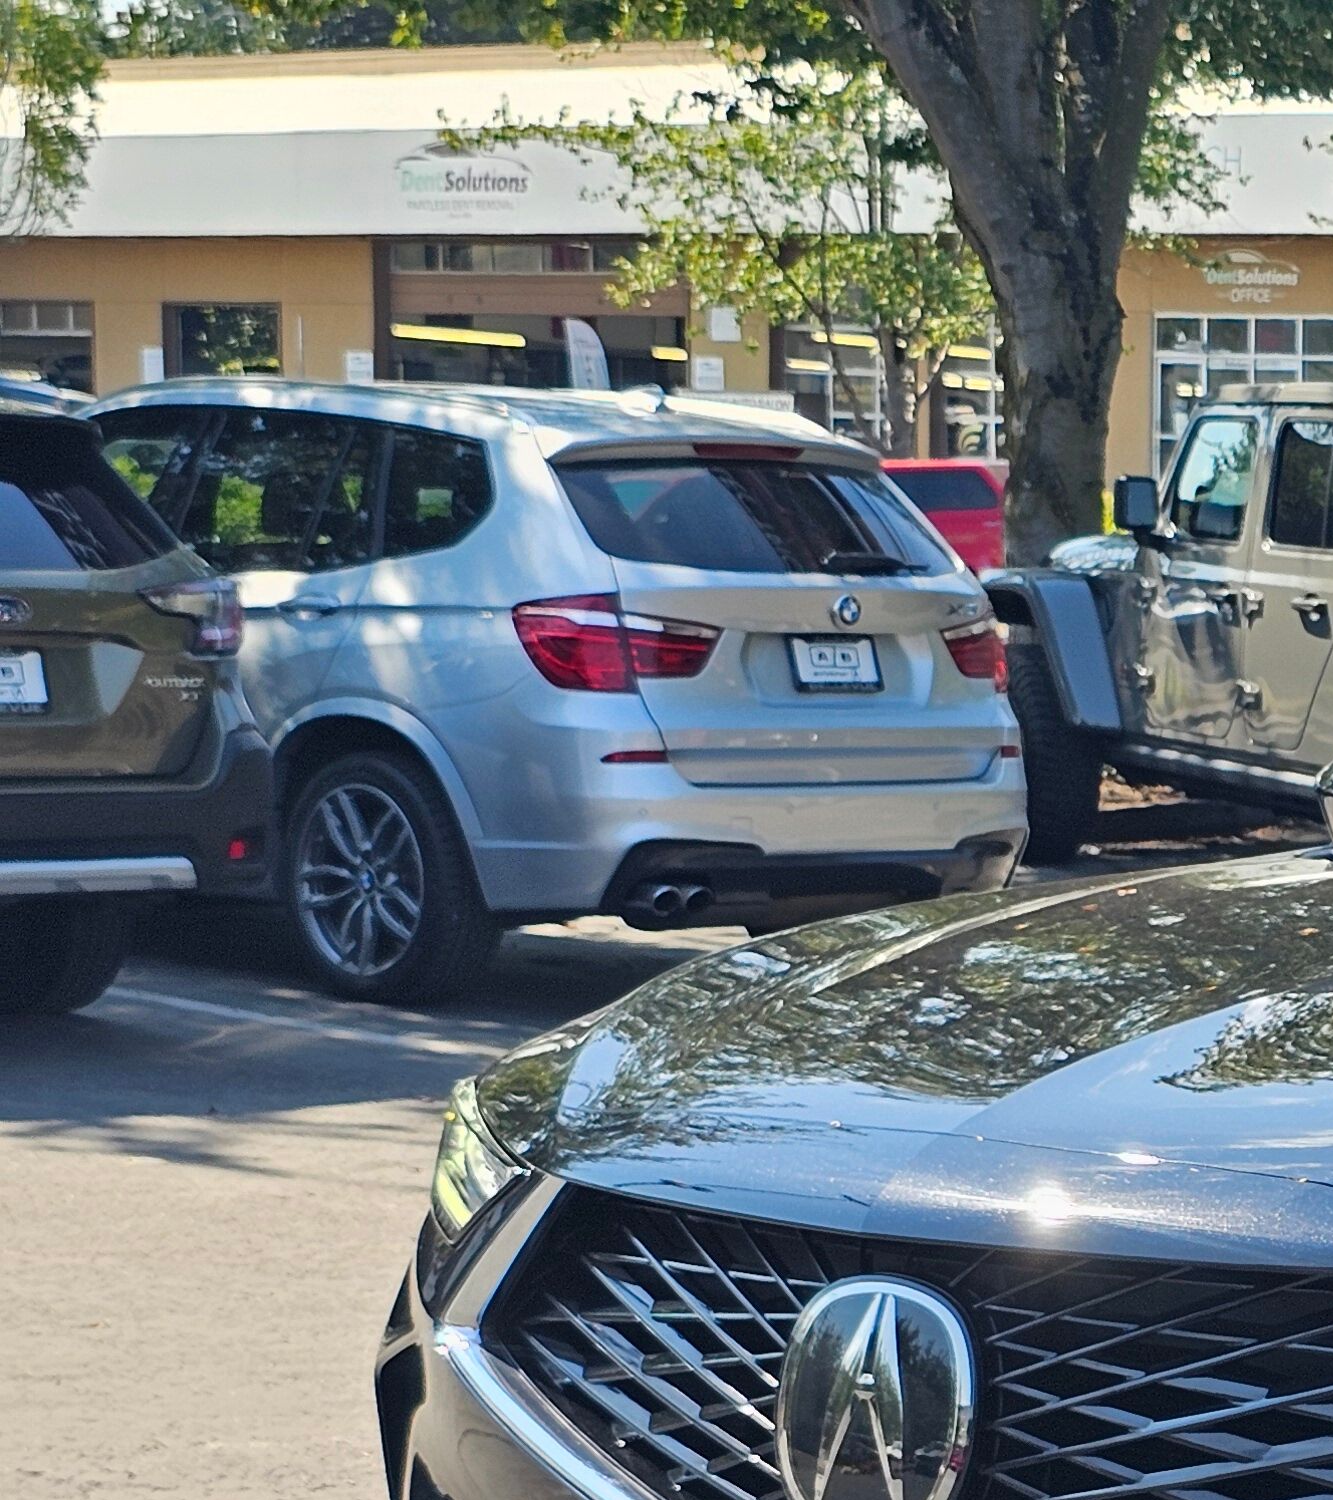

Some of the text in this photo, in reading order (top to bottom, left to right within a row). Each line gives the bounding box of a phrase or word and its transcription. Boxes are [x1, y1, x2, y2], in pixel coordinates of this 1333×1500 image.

[401, 167, 528, 193] DentSolutions
[1206, 266, 1298, 286] DentSolutions
[1231, 288, 1272, 303] OFFICE
